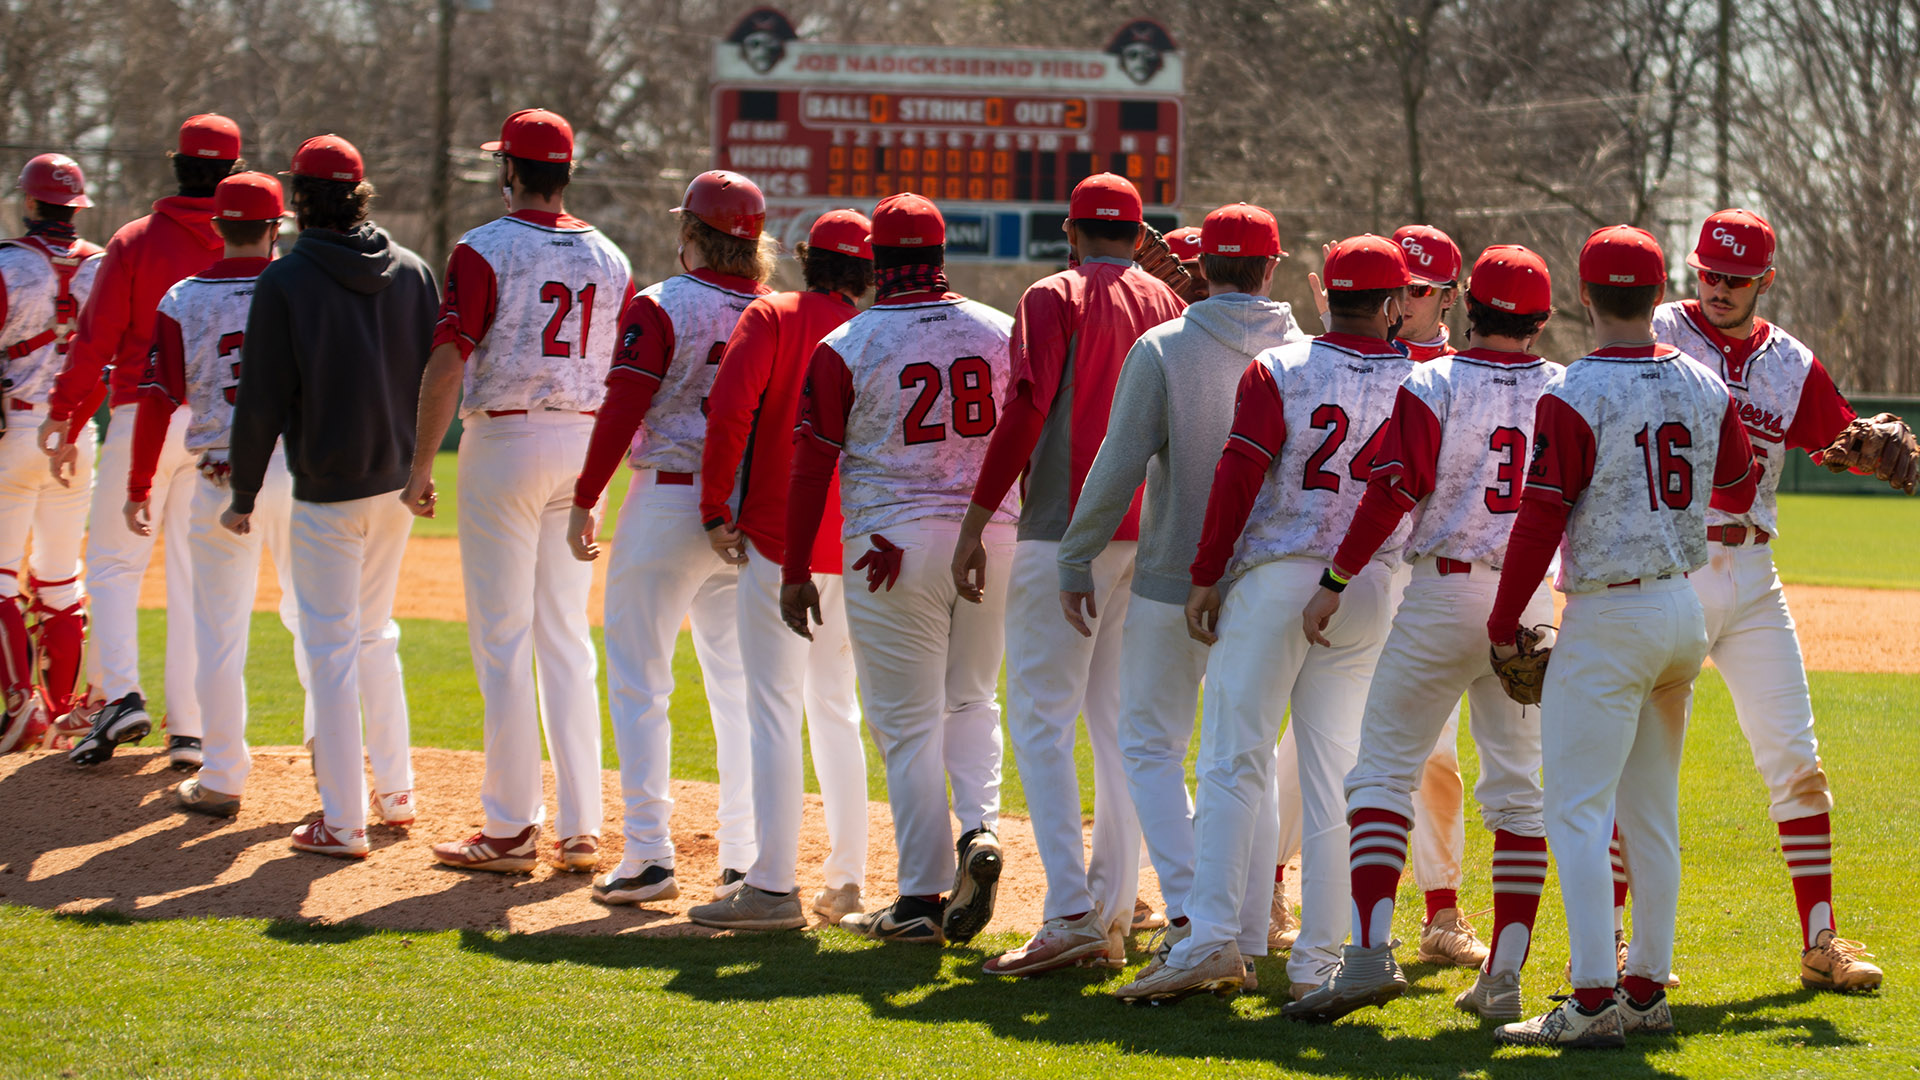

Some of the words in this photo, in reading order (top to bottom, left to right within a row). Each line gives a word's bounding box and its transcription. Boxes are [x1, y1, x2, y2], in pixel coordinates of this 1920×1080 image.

[794, 56, 838, 73] JOE
[845, 57, 1033, 78] NADICKSBERND
[1040, 60, 1106, 80] FIELD
[806, 96, 870, 119] BALL
[870, 94, 888, 123] 0
[899, 97, 985, 122] STRIKE
[985, 97, 1002, 126] 0
[1014, 102, 1063, 124] OUT
[1063, 99, 1085, 128] 2
[751, 122, 788, 140] BAT
[728, 145, 811, 168] VISITOR
[750, 172, 808, 195] UCS
[1401, 236, 1433, 267] CBU
[1711, 227, 1746, 257] CBU
[539, 281, 597, 359] 21
[919, 313, 947, 323] marucci
[1347, 363, 1374, 374] marucci
[898, 355, 997, 447] 28
[1483, 425, 1528, 515] 3
[1634, 421, 1693, 512] 16
